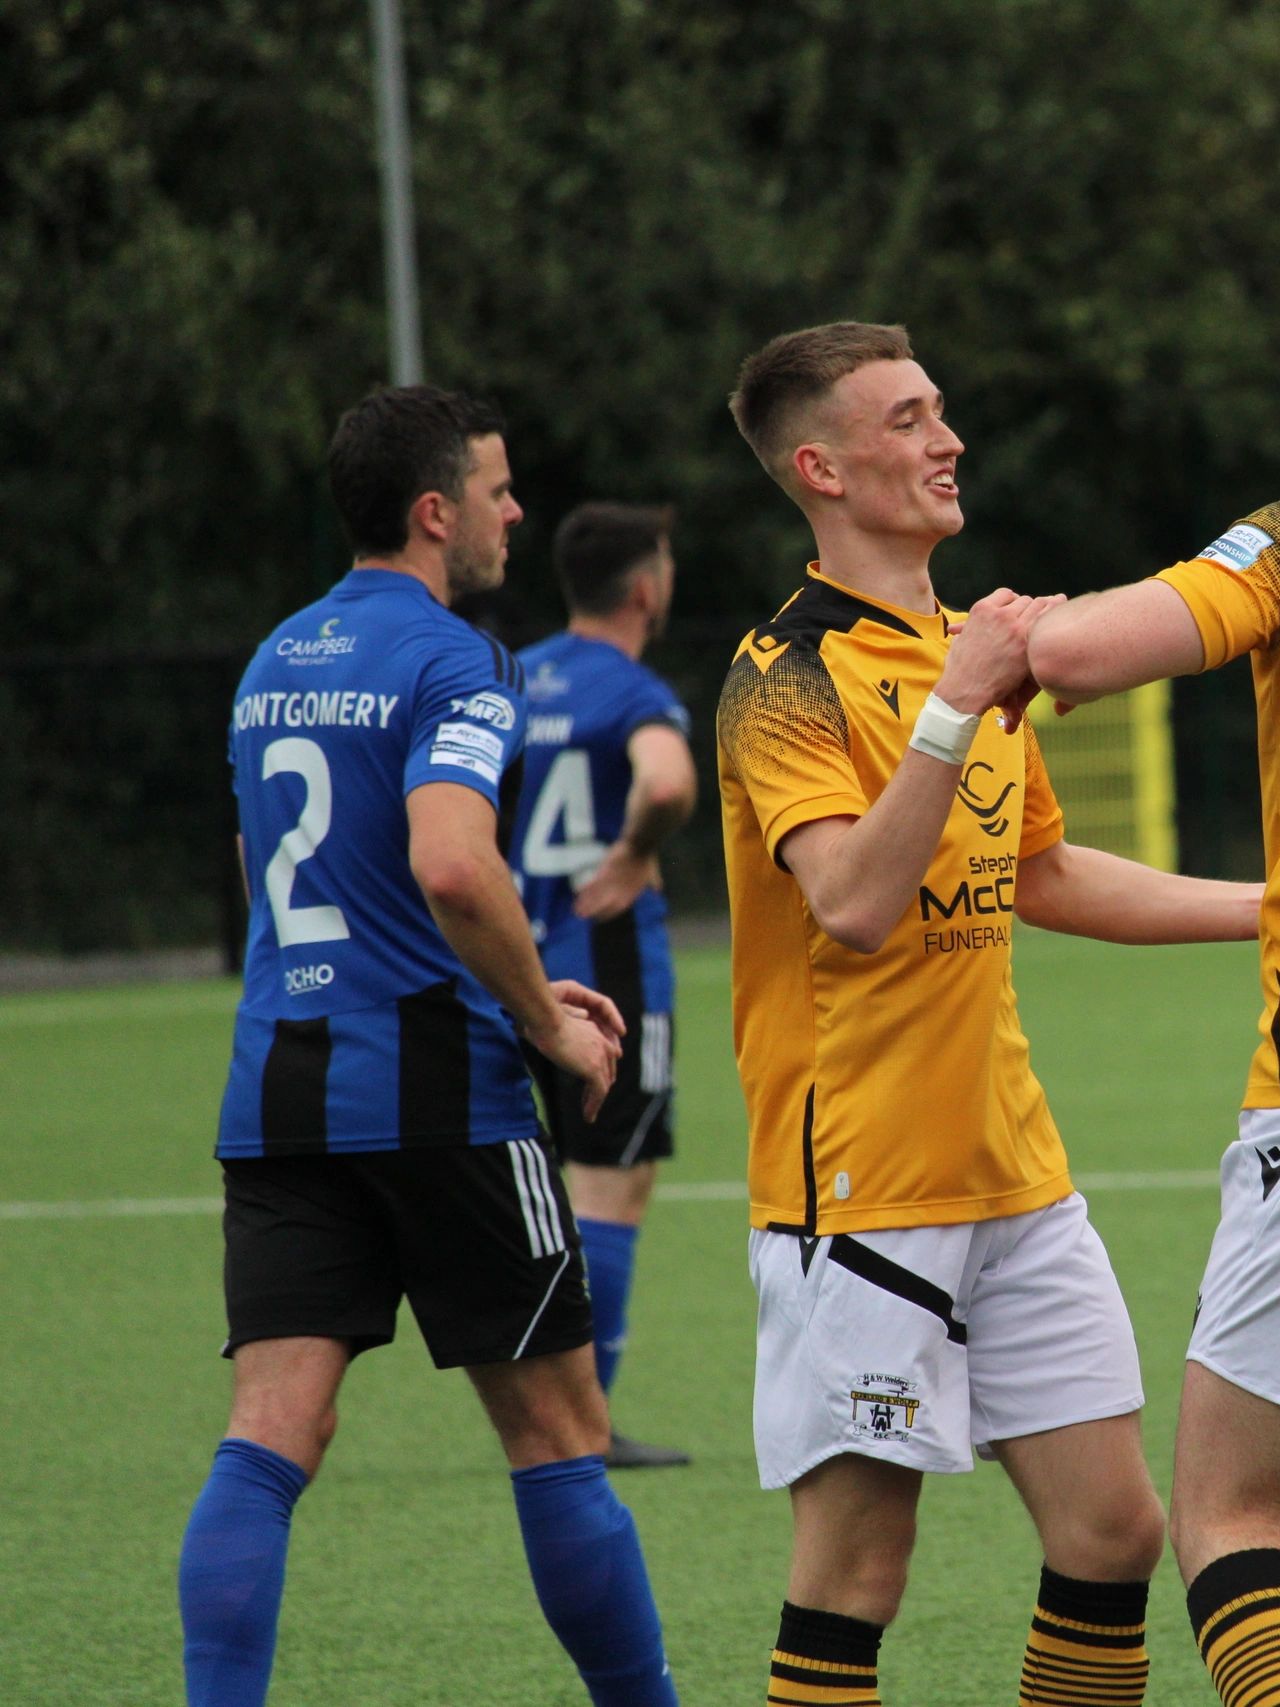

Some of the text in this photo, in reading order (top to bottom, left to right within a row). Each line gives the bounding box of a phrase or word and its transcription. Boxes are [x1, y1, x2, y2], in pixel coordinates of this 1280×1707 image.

[276, 636, 357, 656] CAMPBELL
[262, 737, 351, 949] 2
[522, 747, 610, 893] 4
[968, 852, 1017, 875] Steph
[919, 876, 1015, 922] McC
